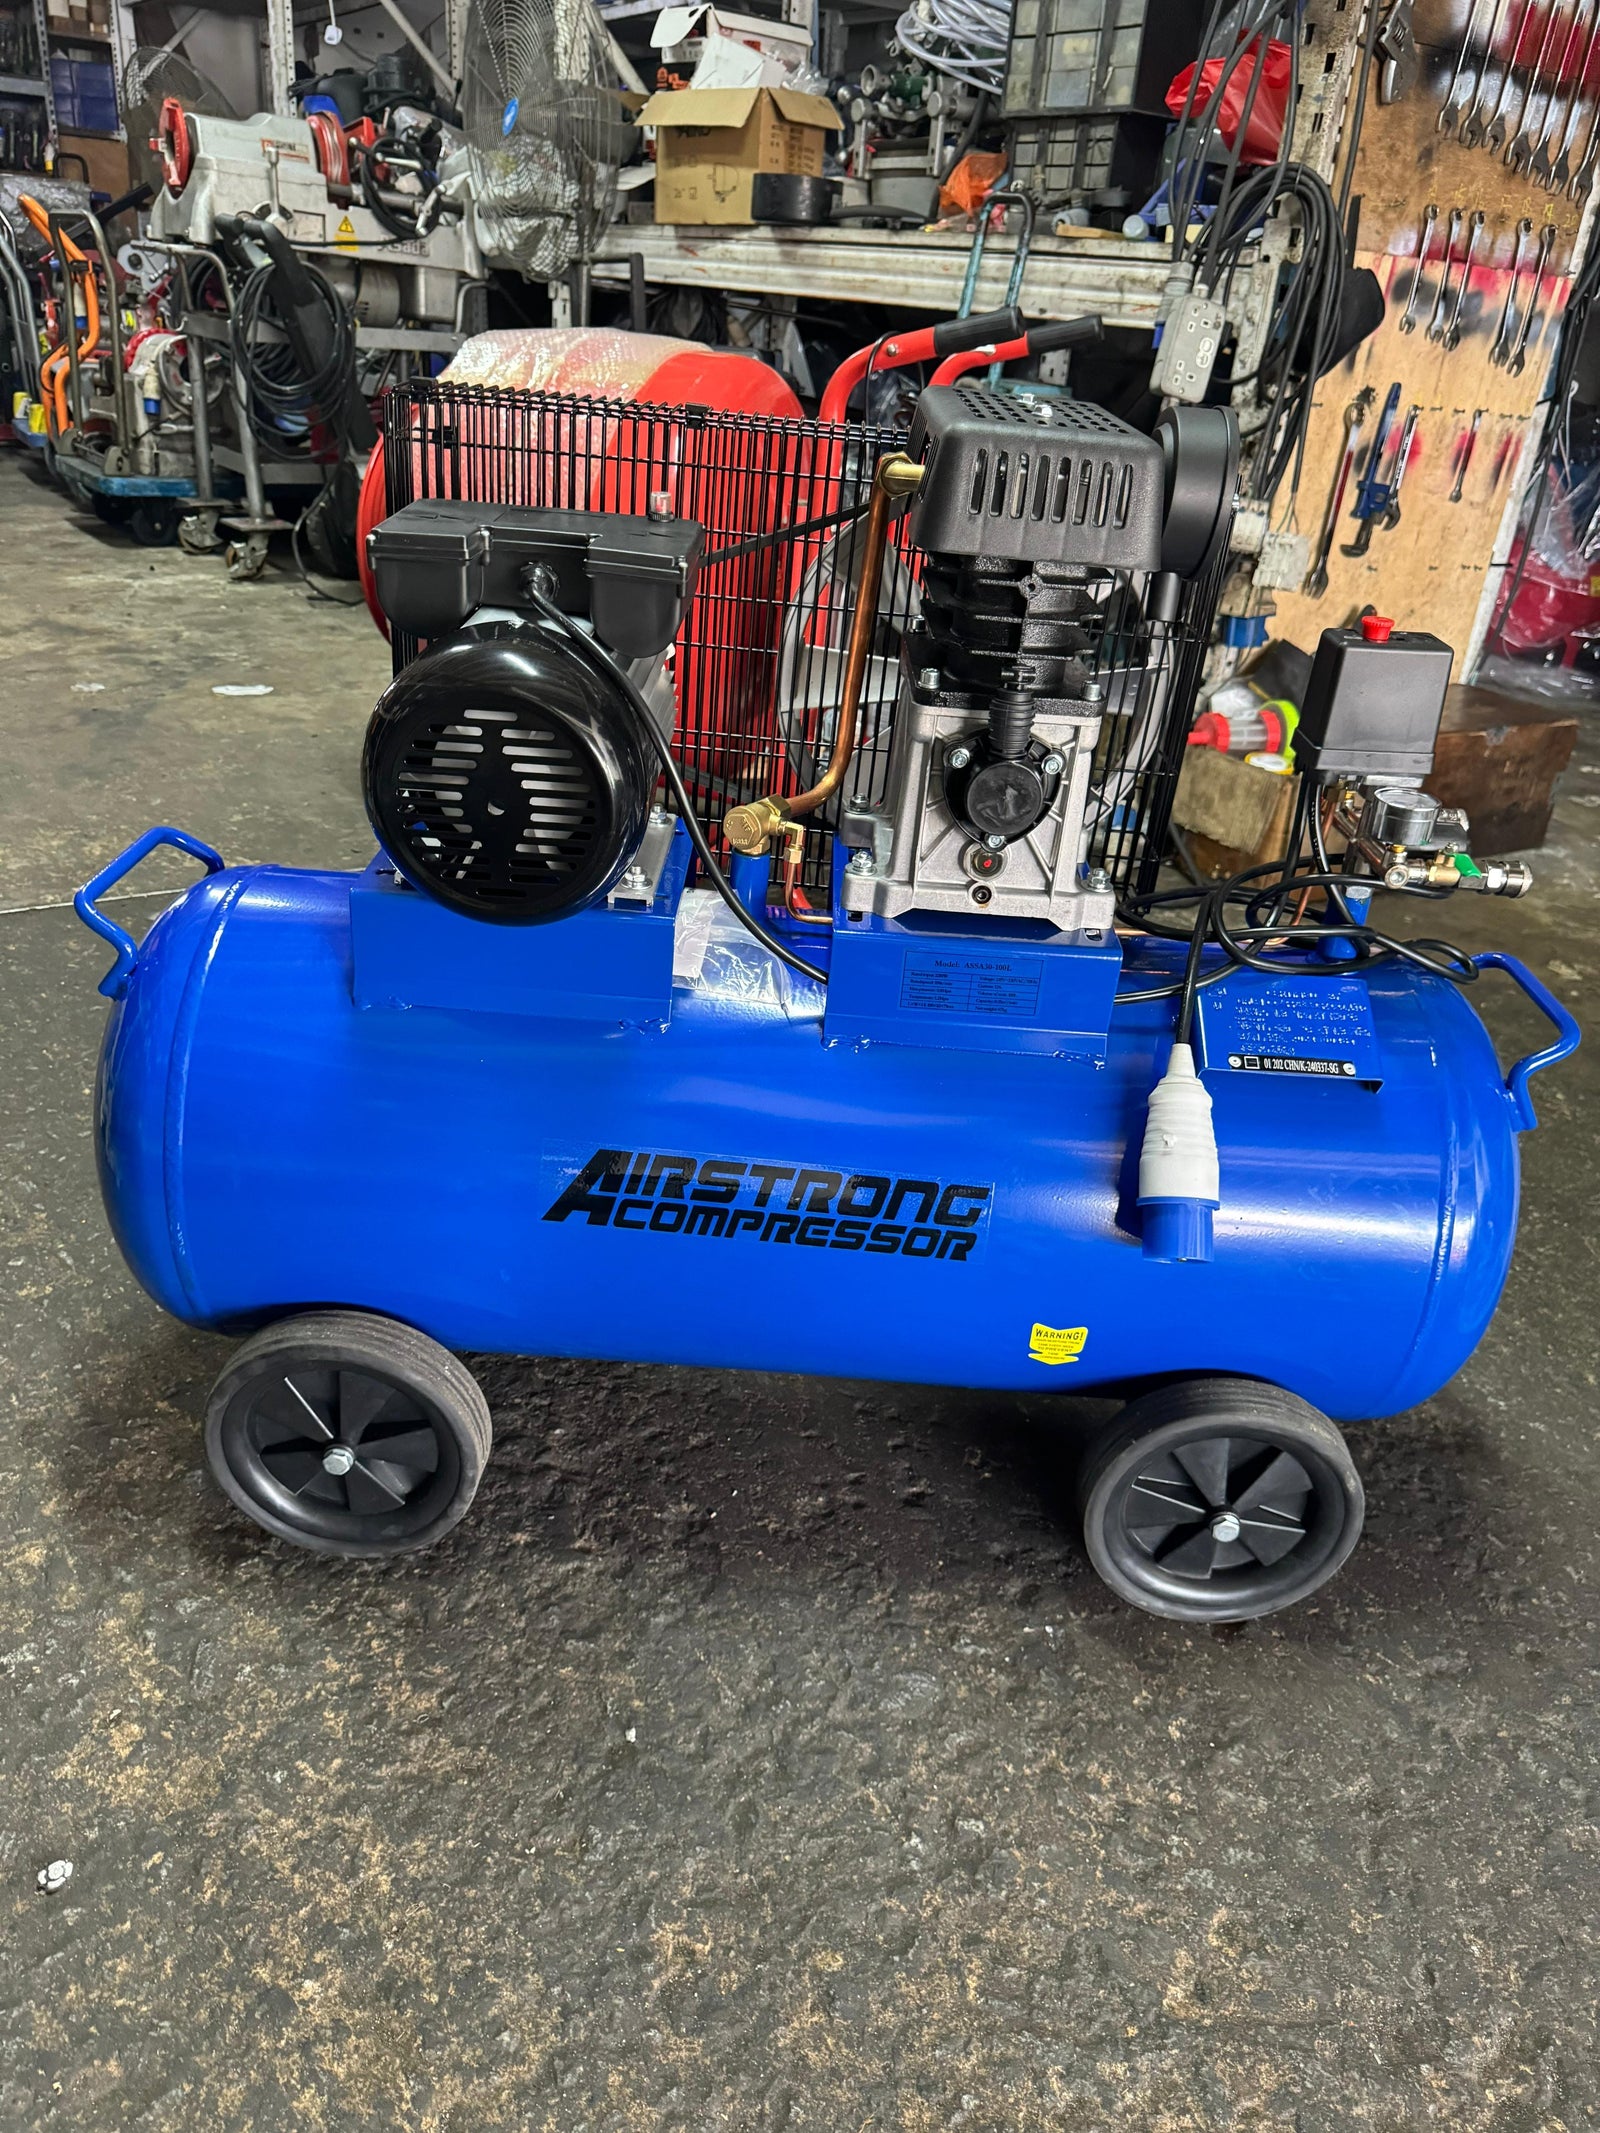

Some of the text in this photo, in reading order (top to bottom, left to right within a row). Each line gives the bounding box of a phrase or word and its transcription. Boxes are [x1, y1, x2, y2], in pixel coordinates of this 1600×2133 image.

[934, 960, 960, 969] Model:
[542, 1148, 990, 1228] AIRSTRONG
[1036, 1328, 1084, 1341] WARNING!
